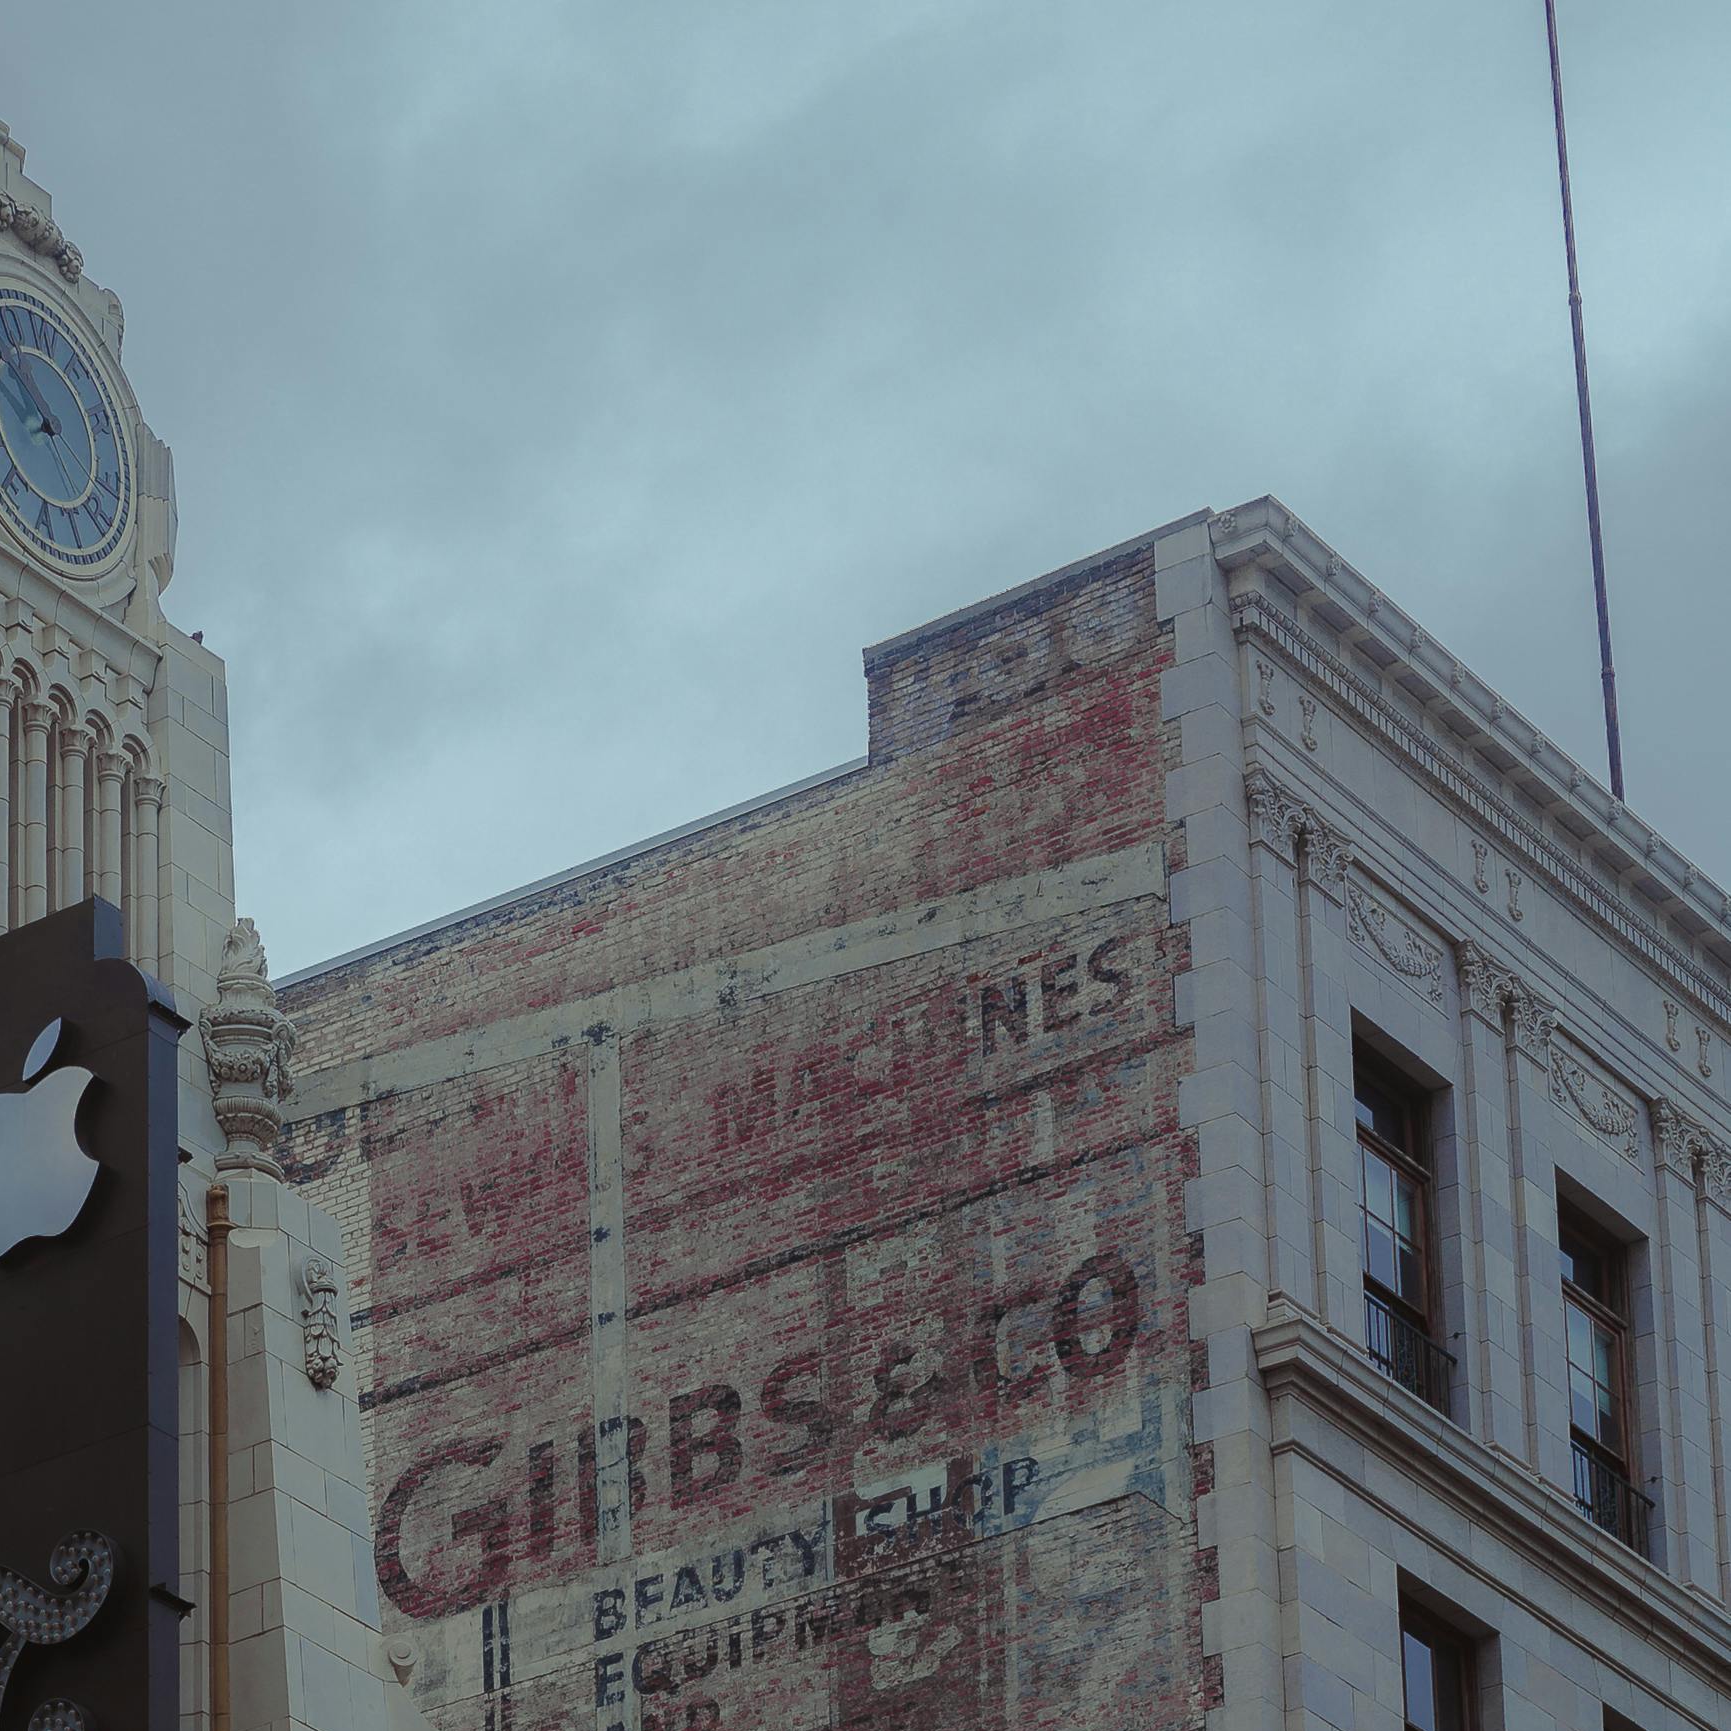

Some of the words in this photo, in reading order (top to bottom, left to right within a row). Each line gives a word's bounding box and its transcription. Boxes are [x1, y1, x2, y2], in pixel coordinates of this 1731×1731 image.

[375, 1352, 843, 1618] GIBBS
[593, 1519, 830, 1641] BEAUTY
[863, 1456, 1040, 1541] SHOP
